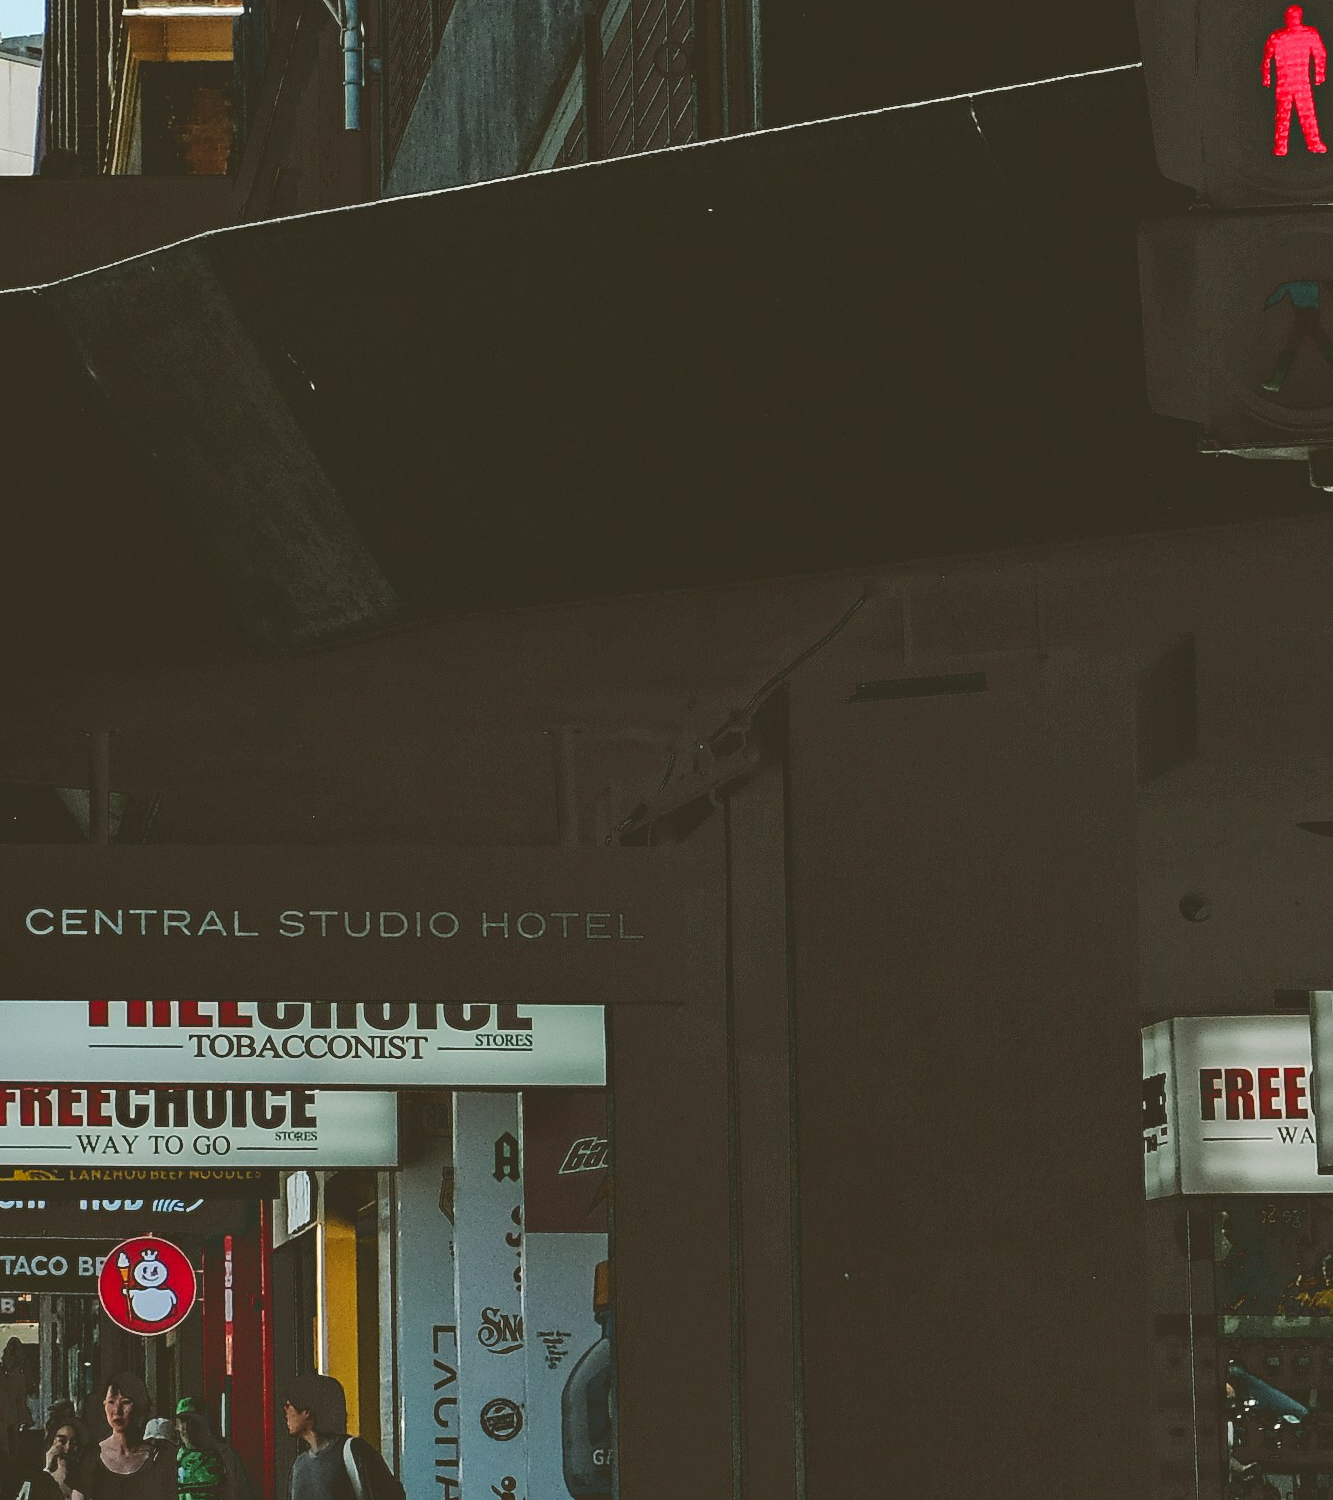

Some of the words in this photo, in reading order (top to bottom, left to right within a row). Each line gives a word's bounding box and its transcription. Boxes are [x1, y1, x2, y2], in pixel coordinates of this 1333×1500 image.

[25, 908, 260, 937] CENTRAL
[278, 910, 460, 939] STUDIO
[481, 911, 645, 941] HOTEL
[188, 1034, 429, 1060] TOBACCONIST
[474, 1033, 533, 1048] STORES
[1199, 1066, 1316, 1122] FREE
[76, 1135, 140, 1155] WAY
[148, 1135, 184, 1155] TO
[193, 1135, 231, 1156] GO
[275, 1131, 318, 1142] STORES
[0, 1256, 68, 1277] TACO
